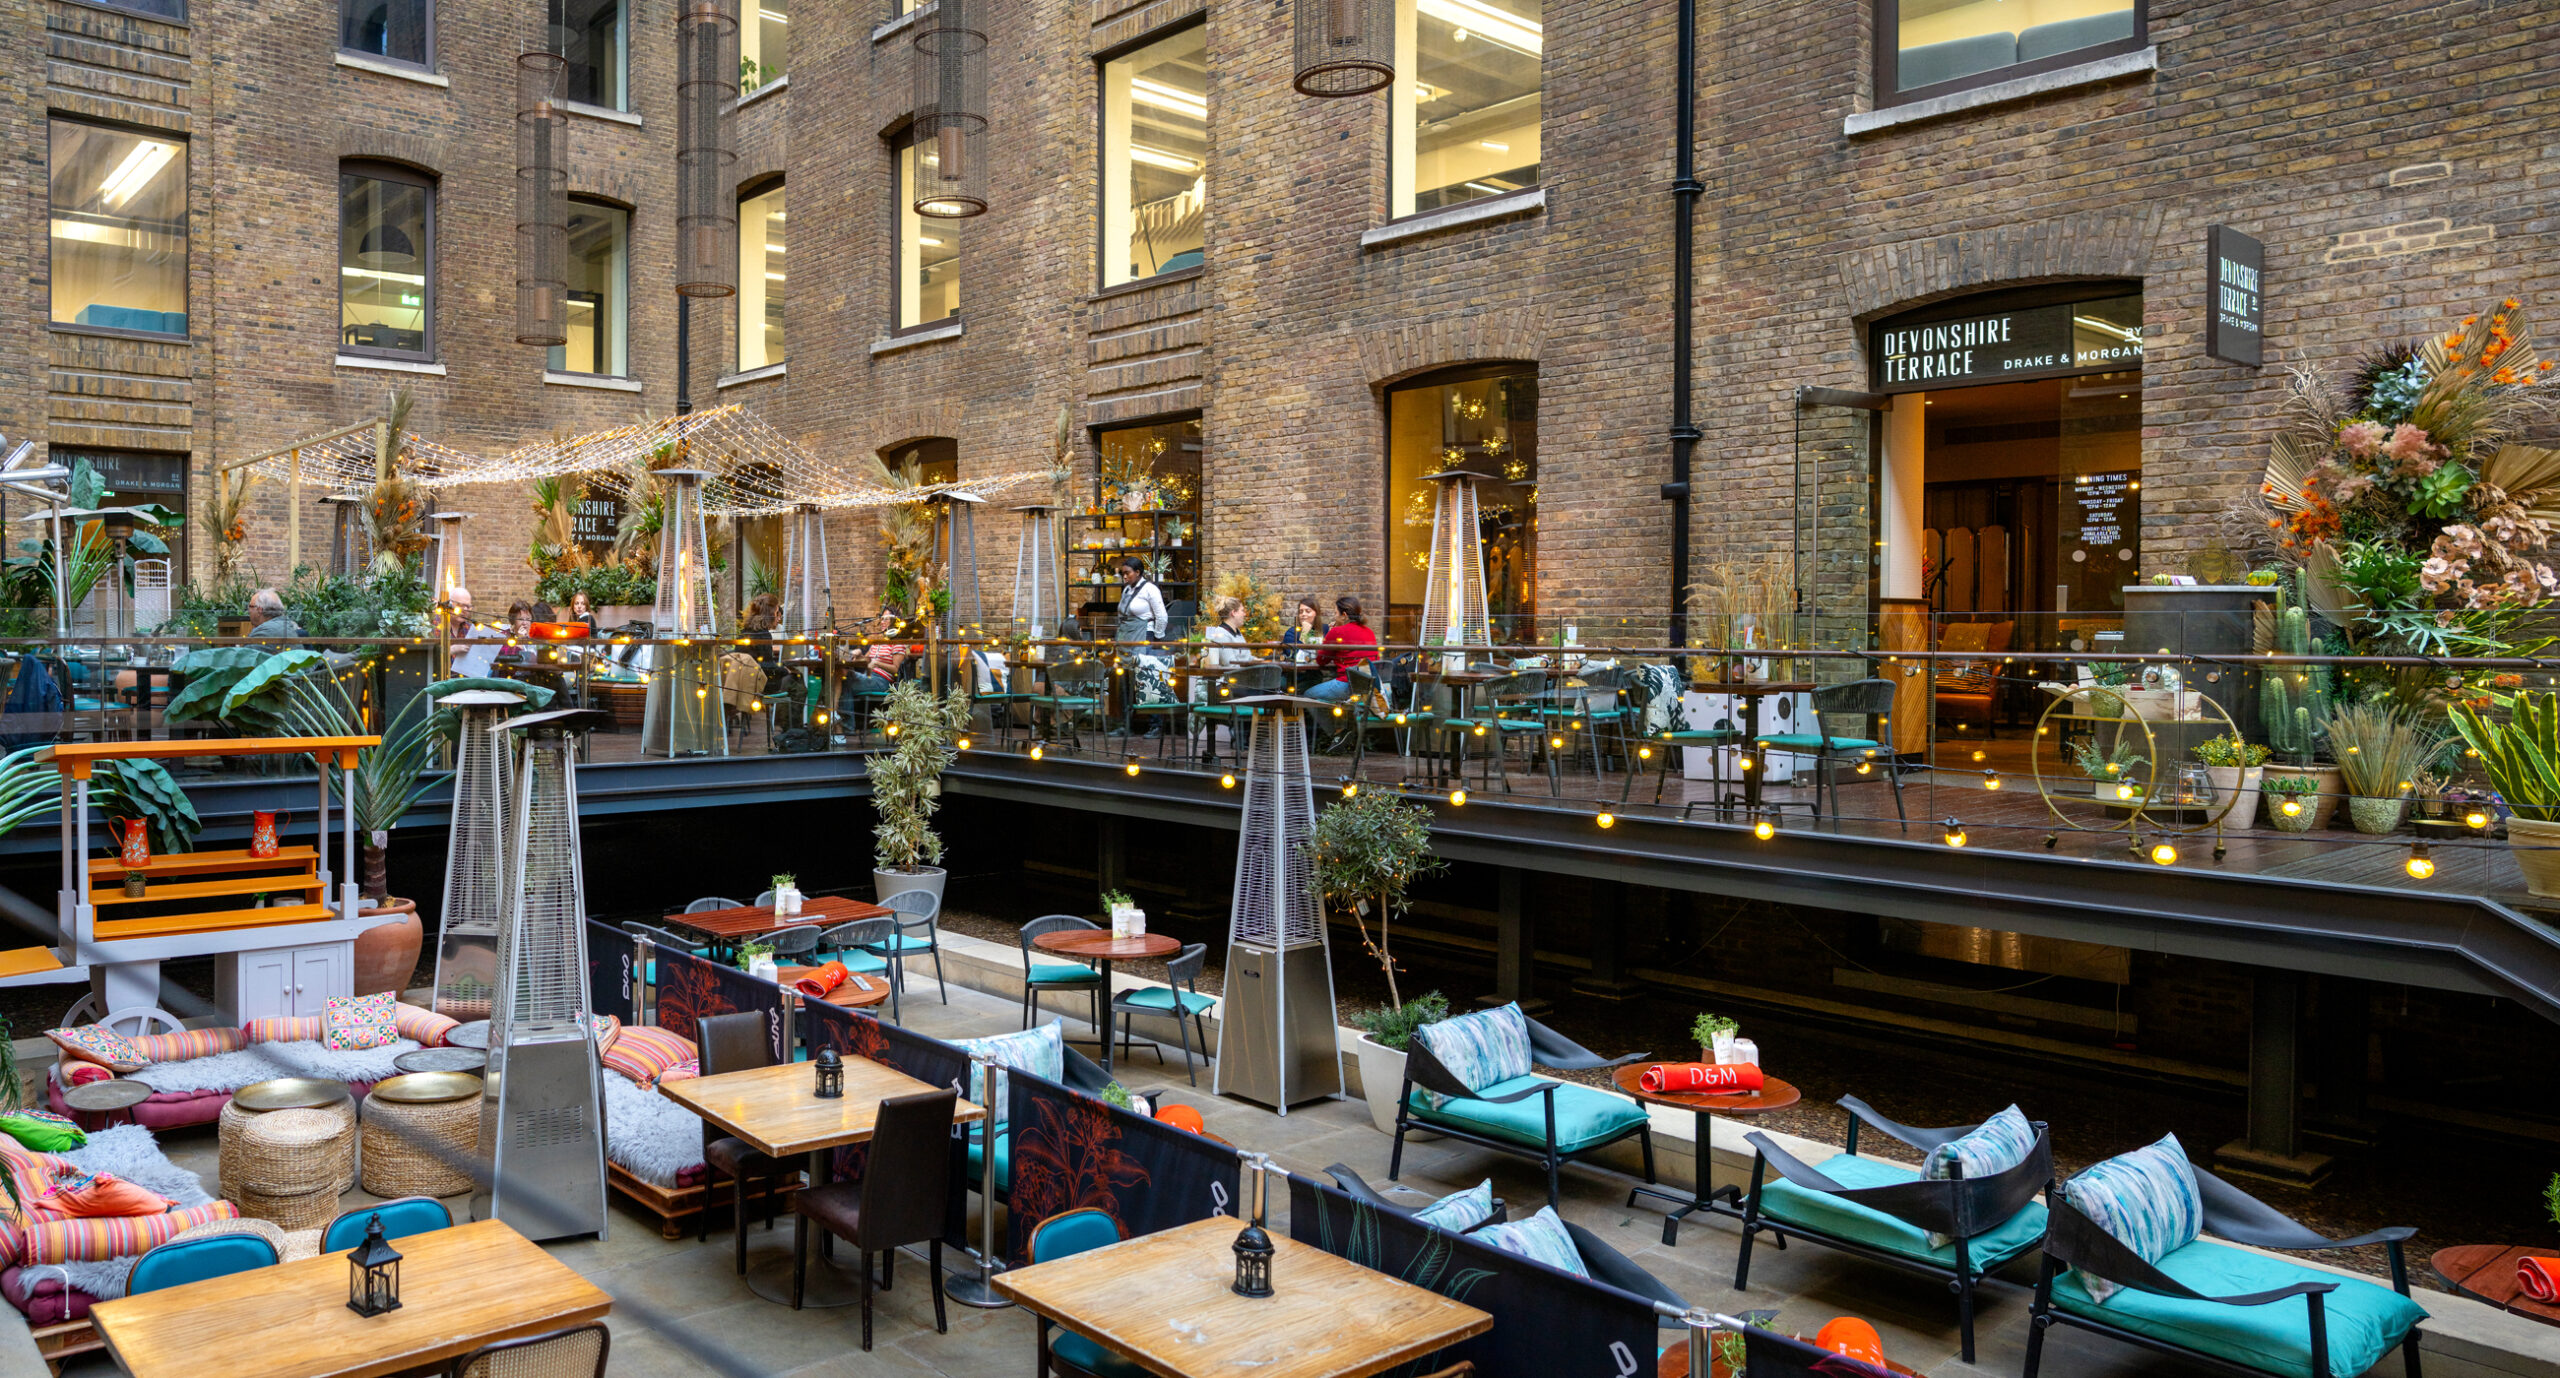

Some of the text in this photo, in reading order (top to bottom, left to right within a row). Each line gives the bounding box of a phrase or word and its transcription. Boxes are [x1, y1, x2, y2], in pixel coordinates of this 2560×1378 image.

[2220, 257, 2258, 293] DEVONSHIRE
[2220, 285, 2248, 317] TERRACE
[1884, 317, 2011, 357] DEVONSHIRE
[2125, 326, 2143, 338] BY
[2003, 344, 2143, 370] DRAKE & MORGAN
[1885, 350, 1974, 383] TERRACE
[53, 453, 120, 471] DEVSHIRE
[115, 479, 139, 487] DRAKE
[150, 481, 180, 489] MORGAN
[2106, 473, 2127, 482] TIMES
[577, 500, 615, 516] NSHIRE
[572, 517, 597, 532] RACE
[1690, 1067, 1737, 1085] D&M
